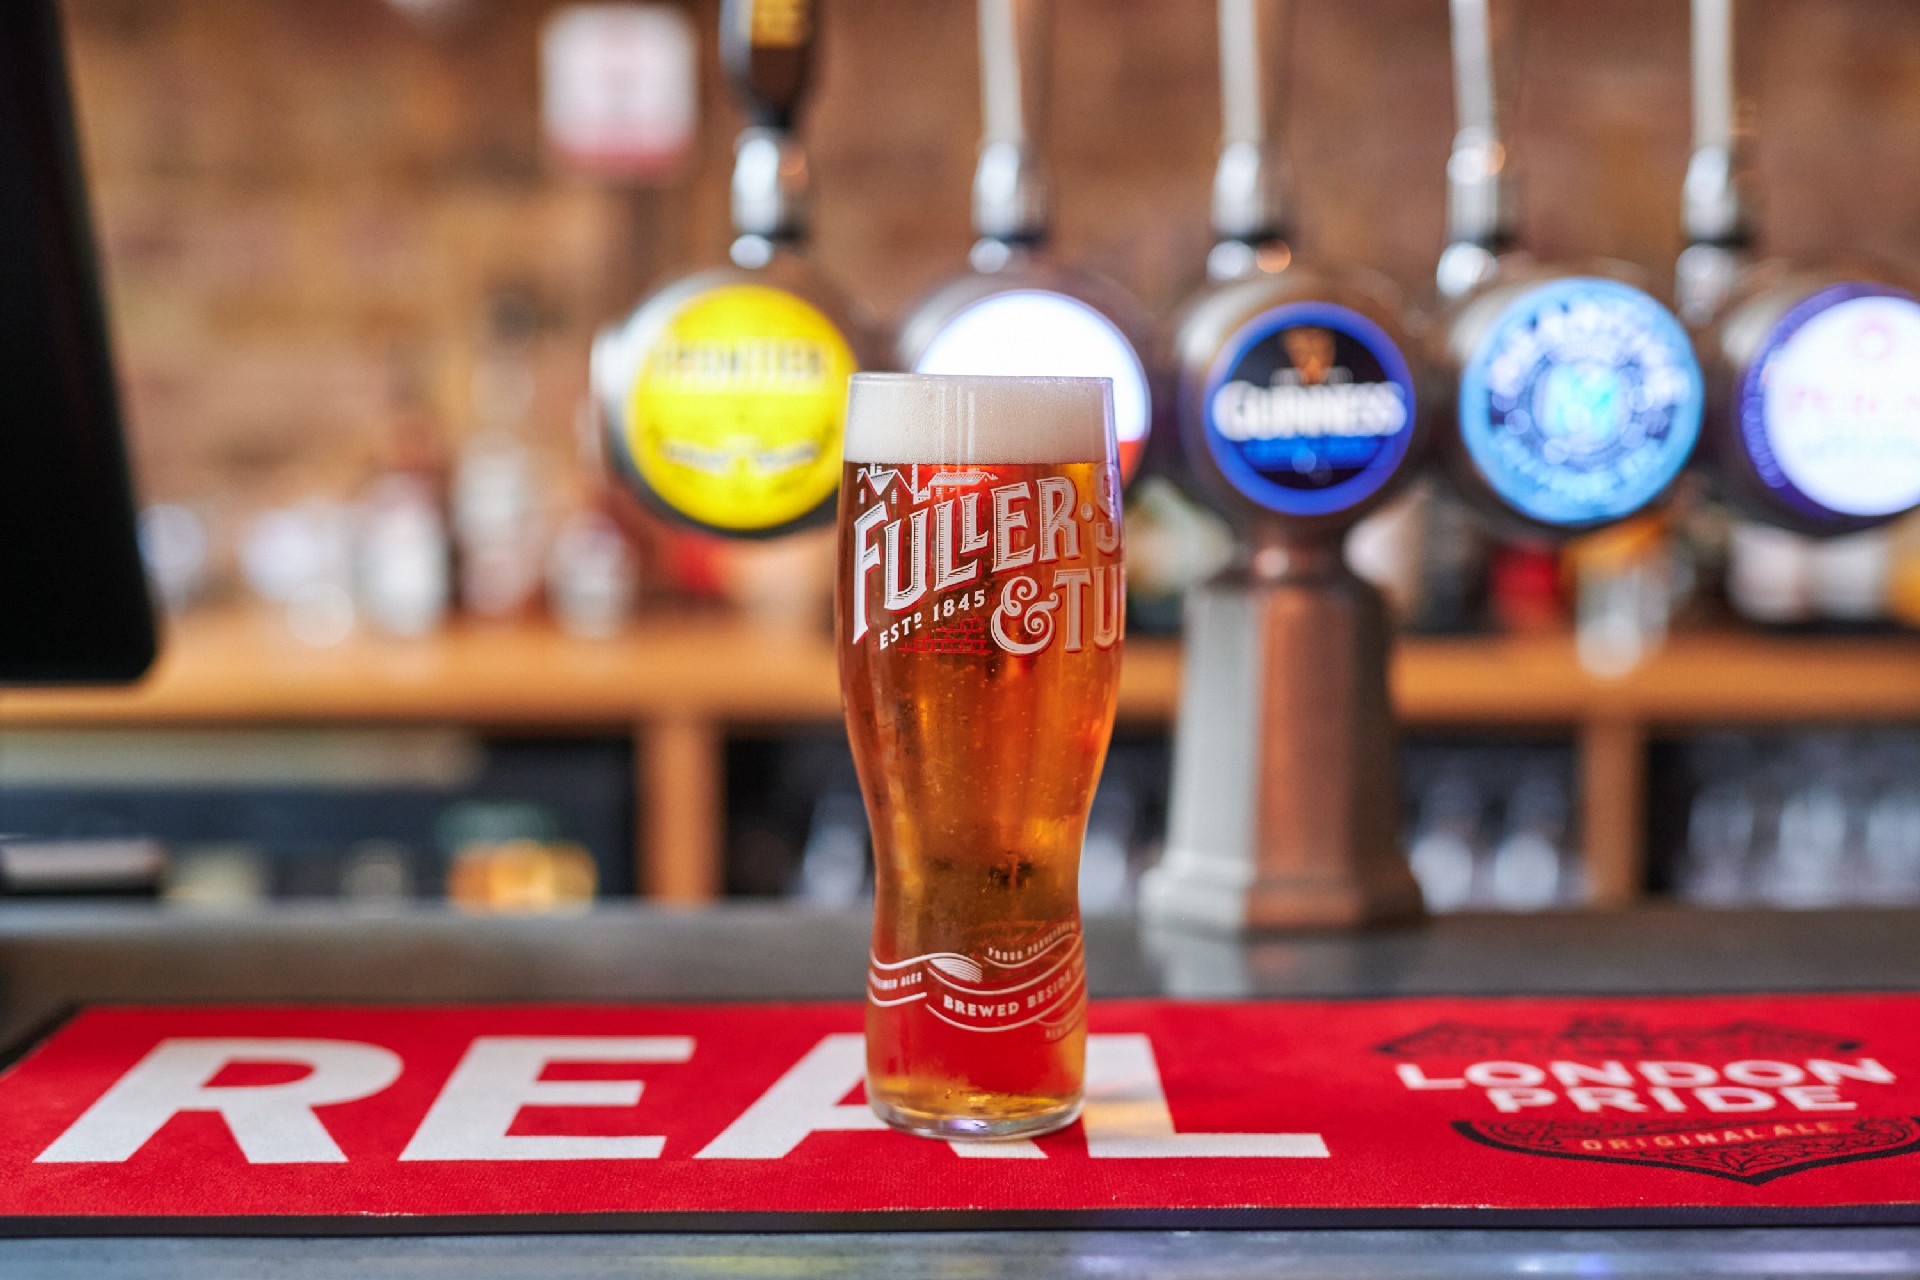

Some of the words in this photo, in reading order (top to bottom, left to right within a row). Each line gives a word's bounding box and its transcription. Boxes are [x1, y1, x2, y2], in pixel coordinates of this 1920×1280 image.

[1212, 380, 1406, 441] GUINNESS
[933, 589, 985, 622] 1845
[1053, 565, 1124, 651] TU
[943, 994, 1020, 1018] BREWED
[1396, 1058, 1896, 1090] LONDON
[33, 1033, 1330, 1164] REAL
[1486, 1086, 1858, 1112] PRIDE
[1581, 1125, 1769, 1151] ORIGINAL
[1773, 1119, 1840, 1138] ALE
